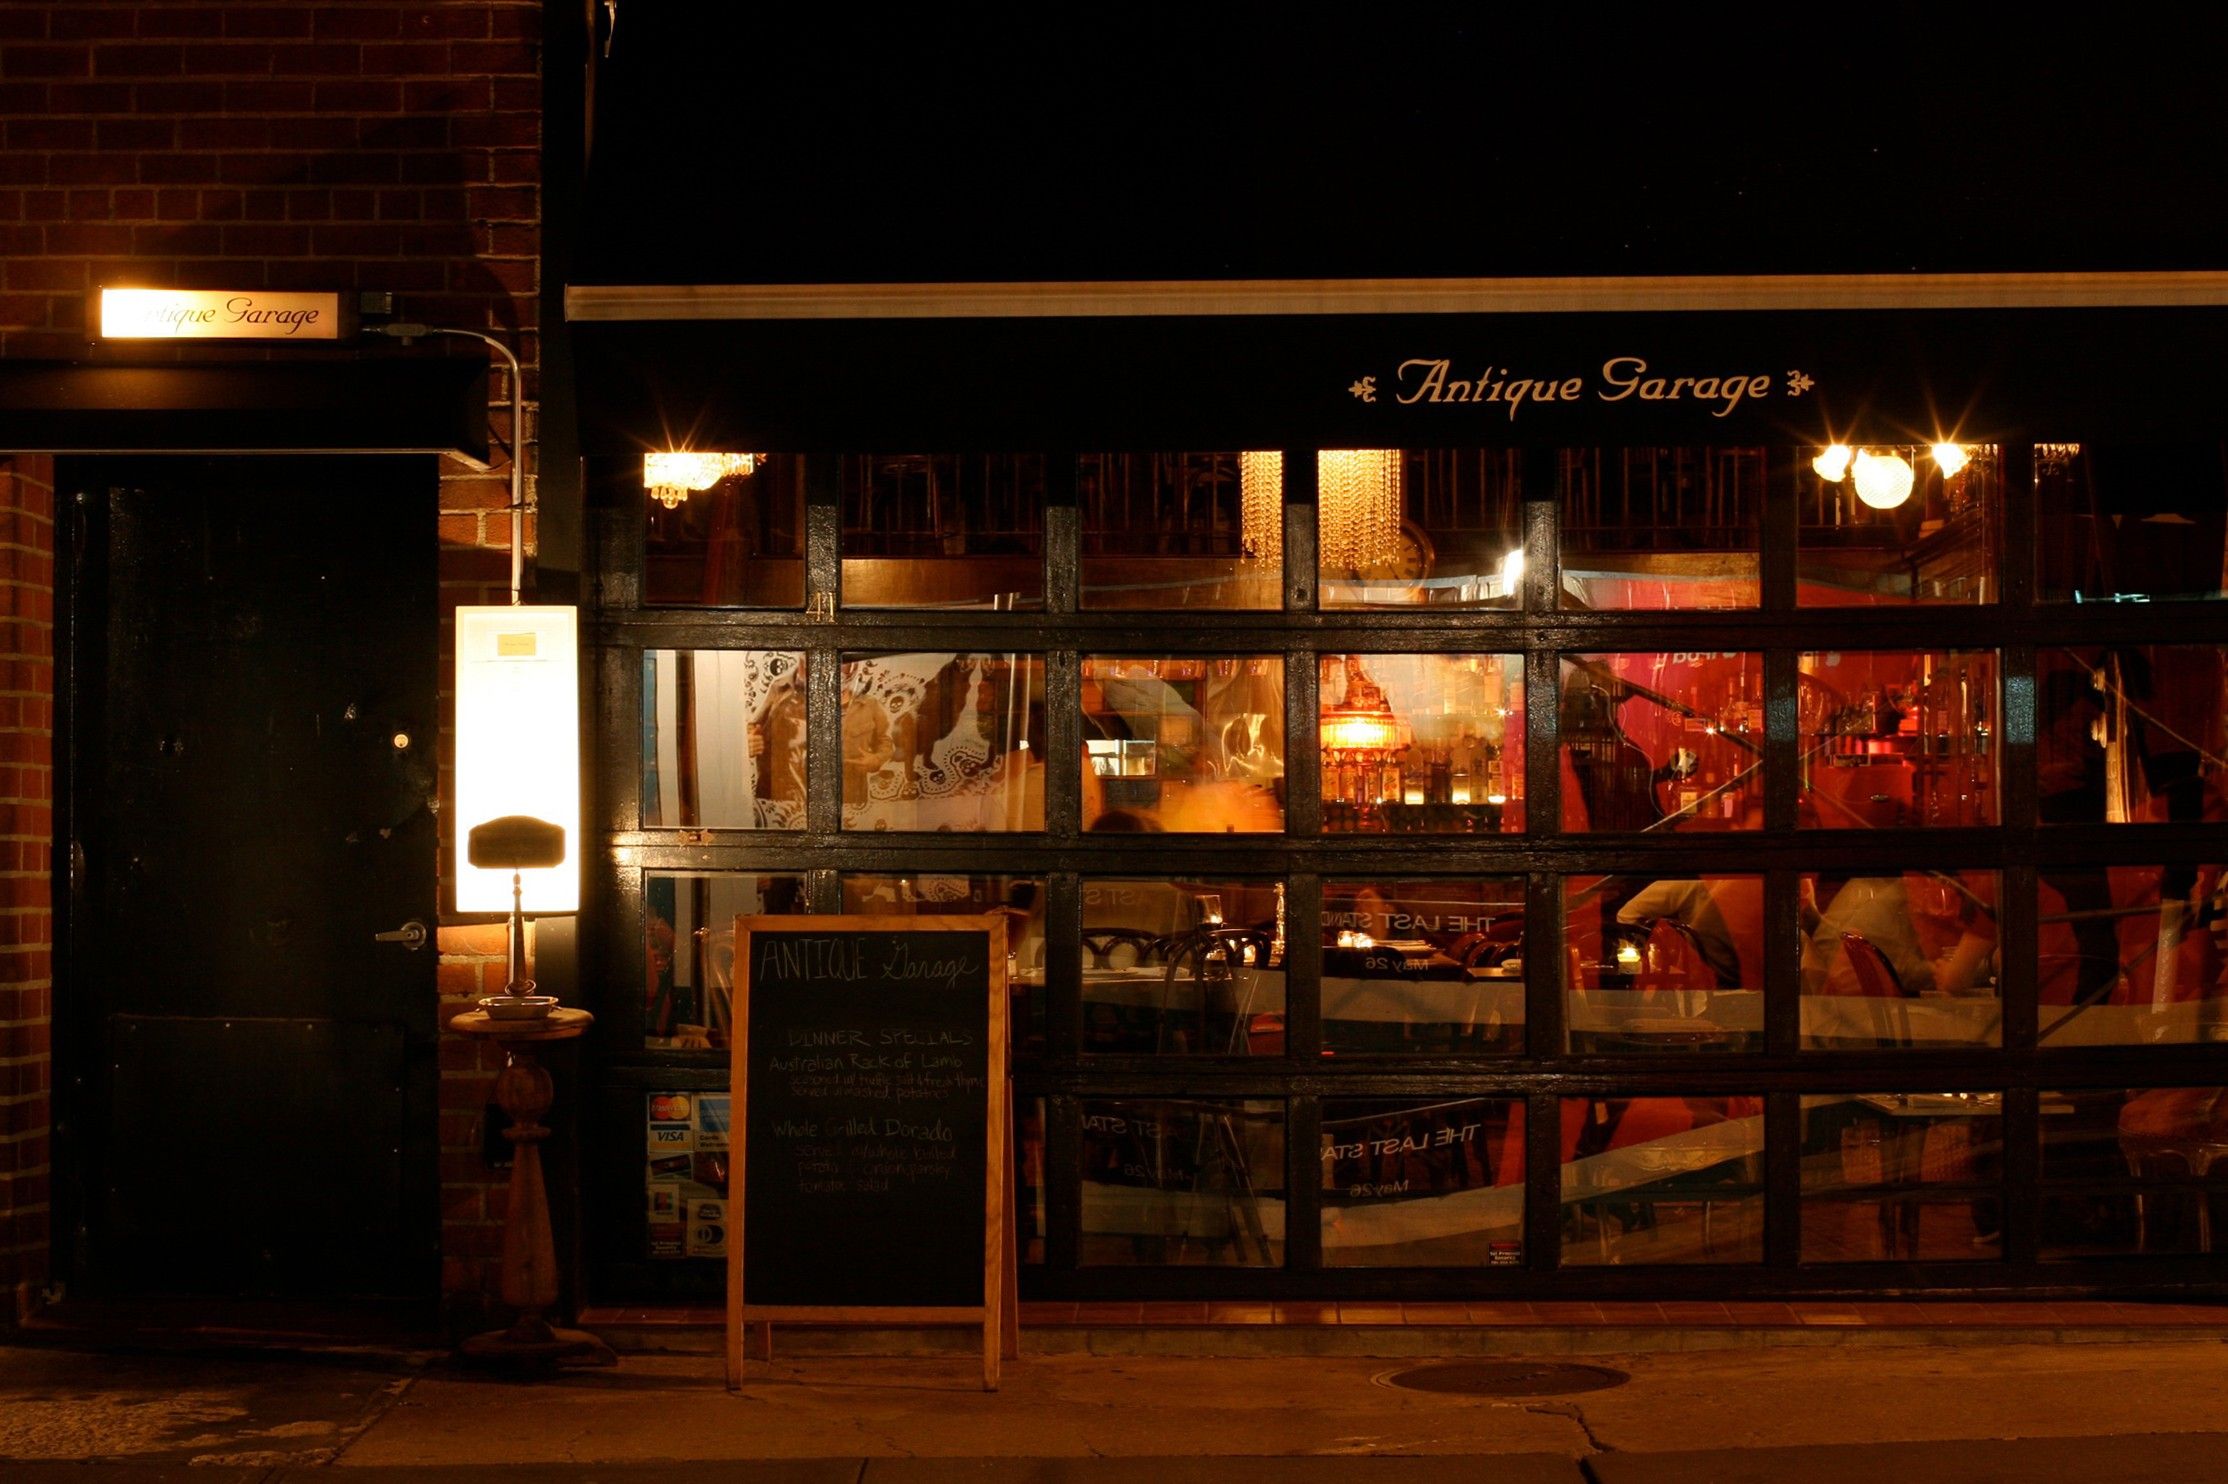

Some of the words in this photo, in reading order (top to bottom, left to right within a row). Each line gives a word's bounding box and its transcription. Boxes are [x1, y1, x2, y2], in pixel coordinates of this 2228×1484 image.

[223, 296, 319, 335] Garage
[1396, 359, 1583, 422] Antique
[1597, 356, 1772, 418] Garage
[759, 937, 869, 983] ANTIQUE
[787, 1029, 872, 1047] DINNER
[768, 1052, 845, 1073] Australian
[894, 1051, 912, 1069] of
[921, 1053, 964, 1070] Lamb
[657, 1131, 684, 1142] VISA
[772, 1117, 818, 1138] Whole
[884, 1117, 954, 1142] Dorado
